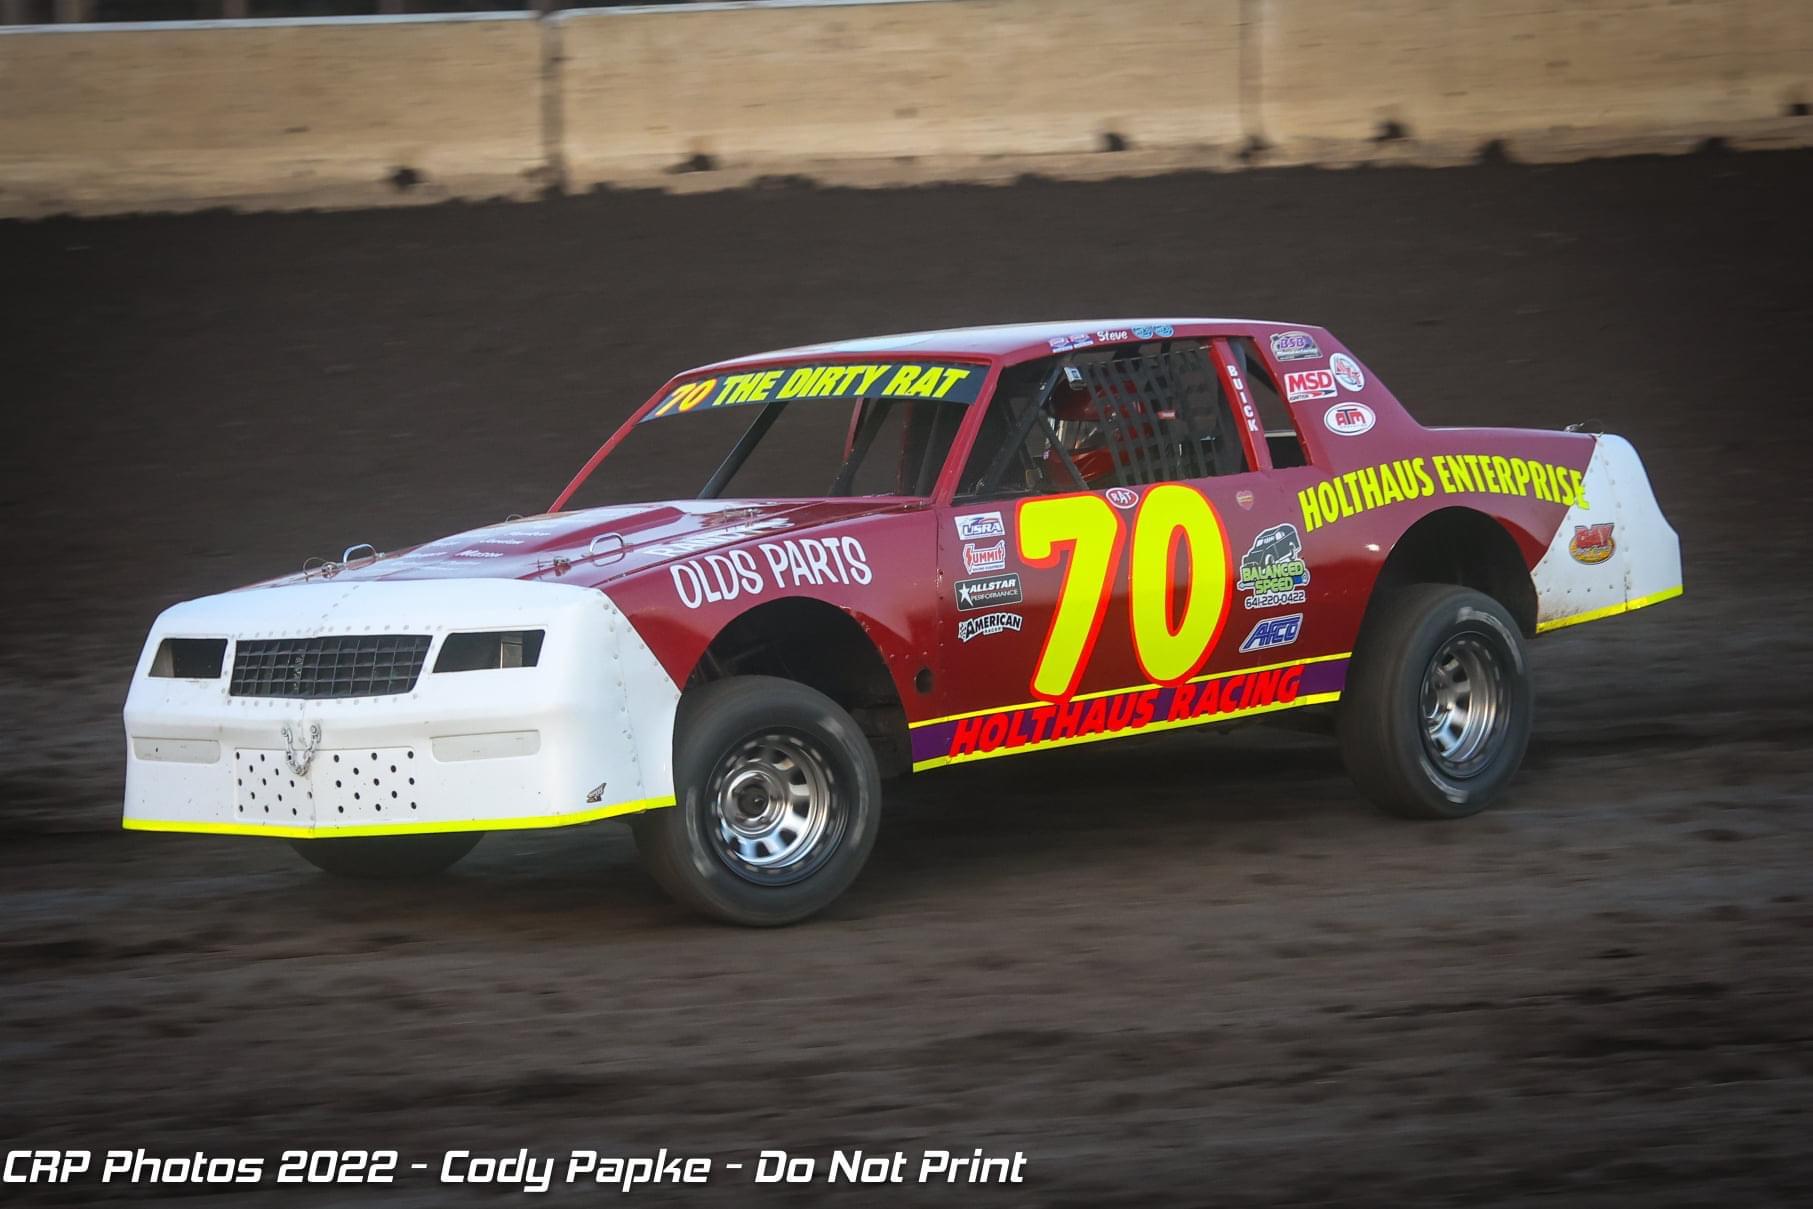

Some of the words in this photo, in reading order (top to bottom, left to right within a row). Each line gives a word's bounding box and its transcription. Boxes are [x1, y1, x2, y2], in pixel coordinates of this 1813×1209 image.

[1096, 330, 1128, 342] Steve
[655, 378, 717, 416] 70
[712, 370, 785, 406] THE
[775, 365, 890, 399] DIRTY
[881, 365, 970, 399] RAT
[1288, 371, 1332, 393] MSD
[1226, 365, 1258, 432] BUICK
[1110, 491, 1132, 504] RAT
[1298, 457, 1435, 533] HOLTHAUS
[1431, 454, 1590, 511] ENTERPRISE
[962, 523, 1003, 536] USRA
[669, 549, 764, 609] OLDS
[758, 536, 873, 588] PARTS
[1241, 561, 1305, 582] BALANCED
[969, 578, 1017, 594] ALLSTAR
[970, 589, 1019, 601] PERFORMANCE
[1015, 481, 1235, 704] 70
[1255, 577, 1295, 595] SPEED
[965, 614, 1021, 639] AMERICAN
[949, 688, 1160, 757] HOLTHAUS
[1167, 664, 1305, 722] RACING
